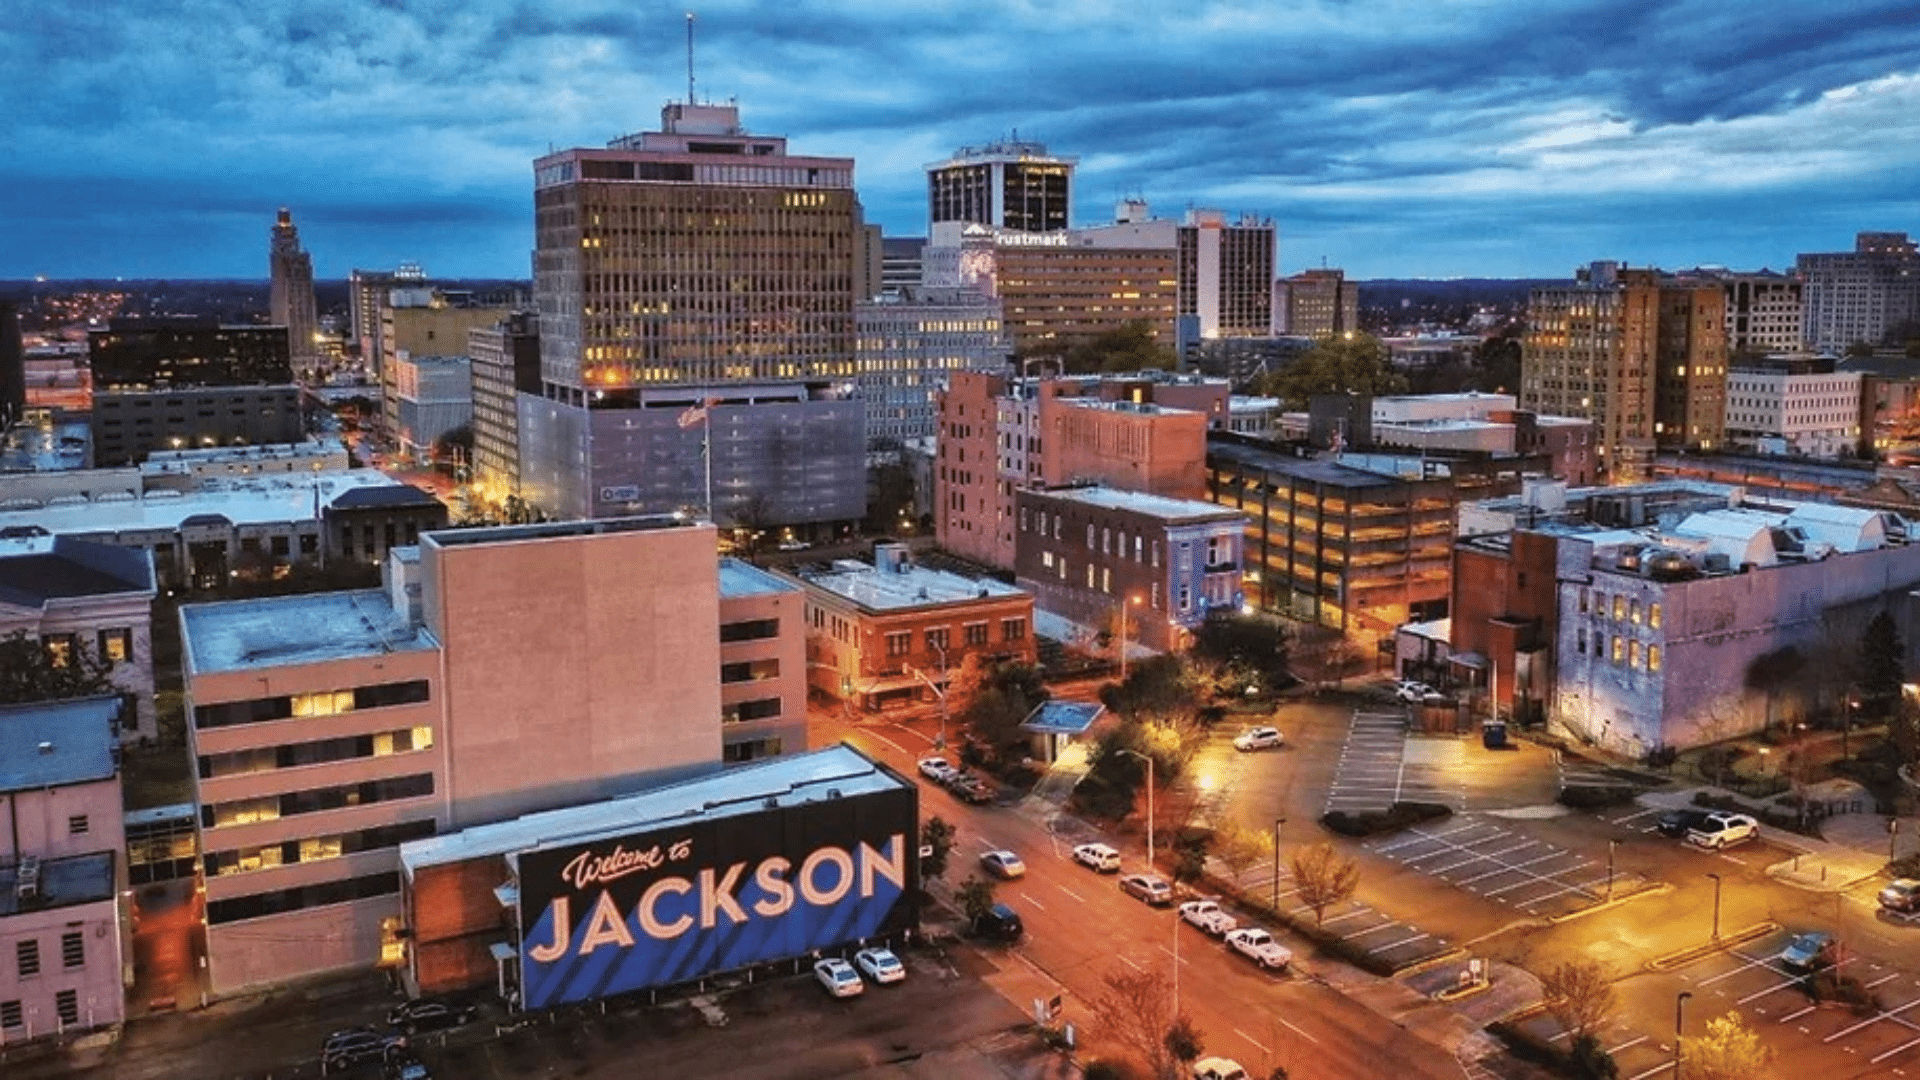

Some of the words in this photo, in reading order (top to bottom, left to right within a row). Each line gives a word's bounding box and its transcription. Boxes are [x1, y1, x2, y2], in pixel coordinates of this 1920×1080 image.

[529, 833, 906, 963] JACKSON
[561, 844, 664, 890] Welcome
[668, 838, 693, 861] to
